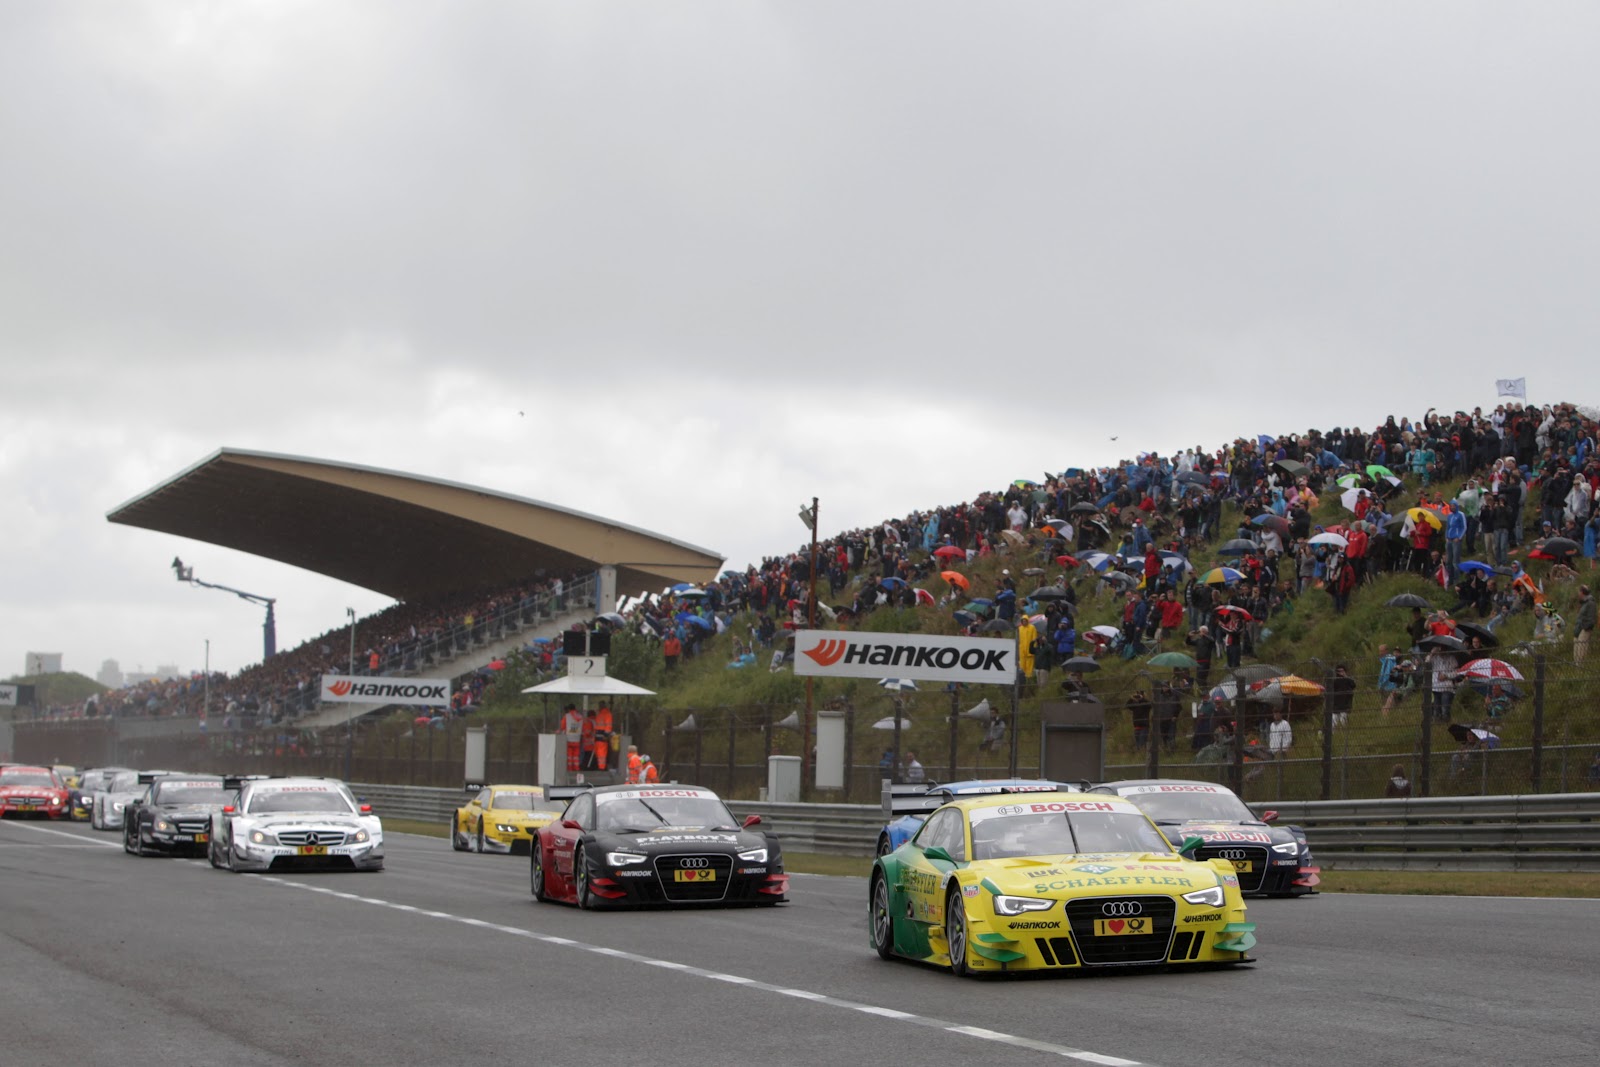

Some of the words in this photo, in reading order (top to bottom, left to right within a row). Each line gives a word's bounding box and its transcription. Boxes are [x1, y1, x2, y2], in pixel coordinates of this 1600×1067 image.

[639, 790, 699, 798] BOSCH
[1160, 785, 1217, 793] BOSCH
[1030, 802, 1114, 813] BOSCH
[636, 834, 720, 843] PLAYBOY
[1228, 831, 1272, 844] Bull
[1034, 876, 1194, 894] SCHAEFFLER
